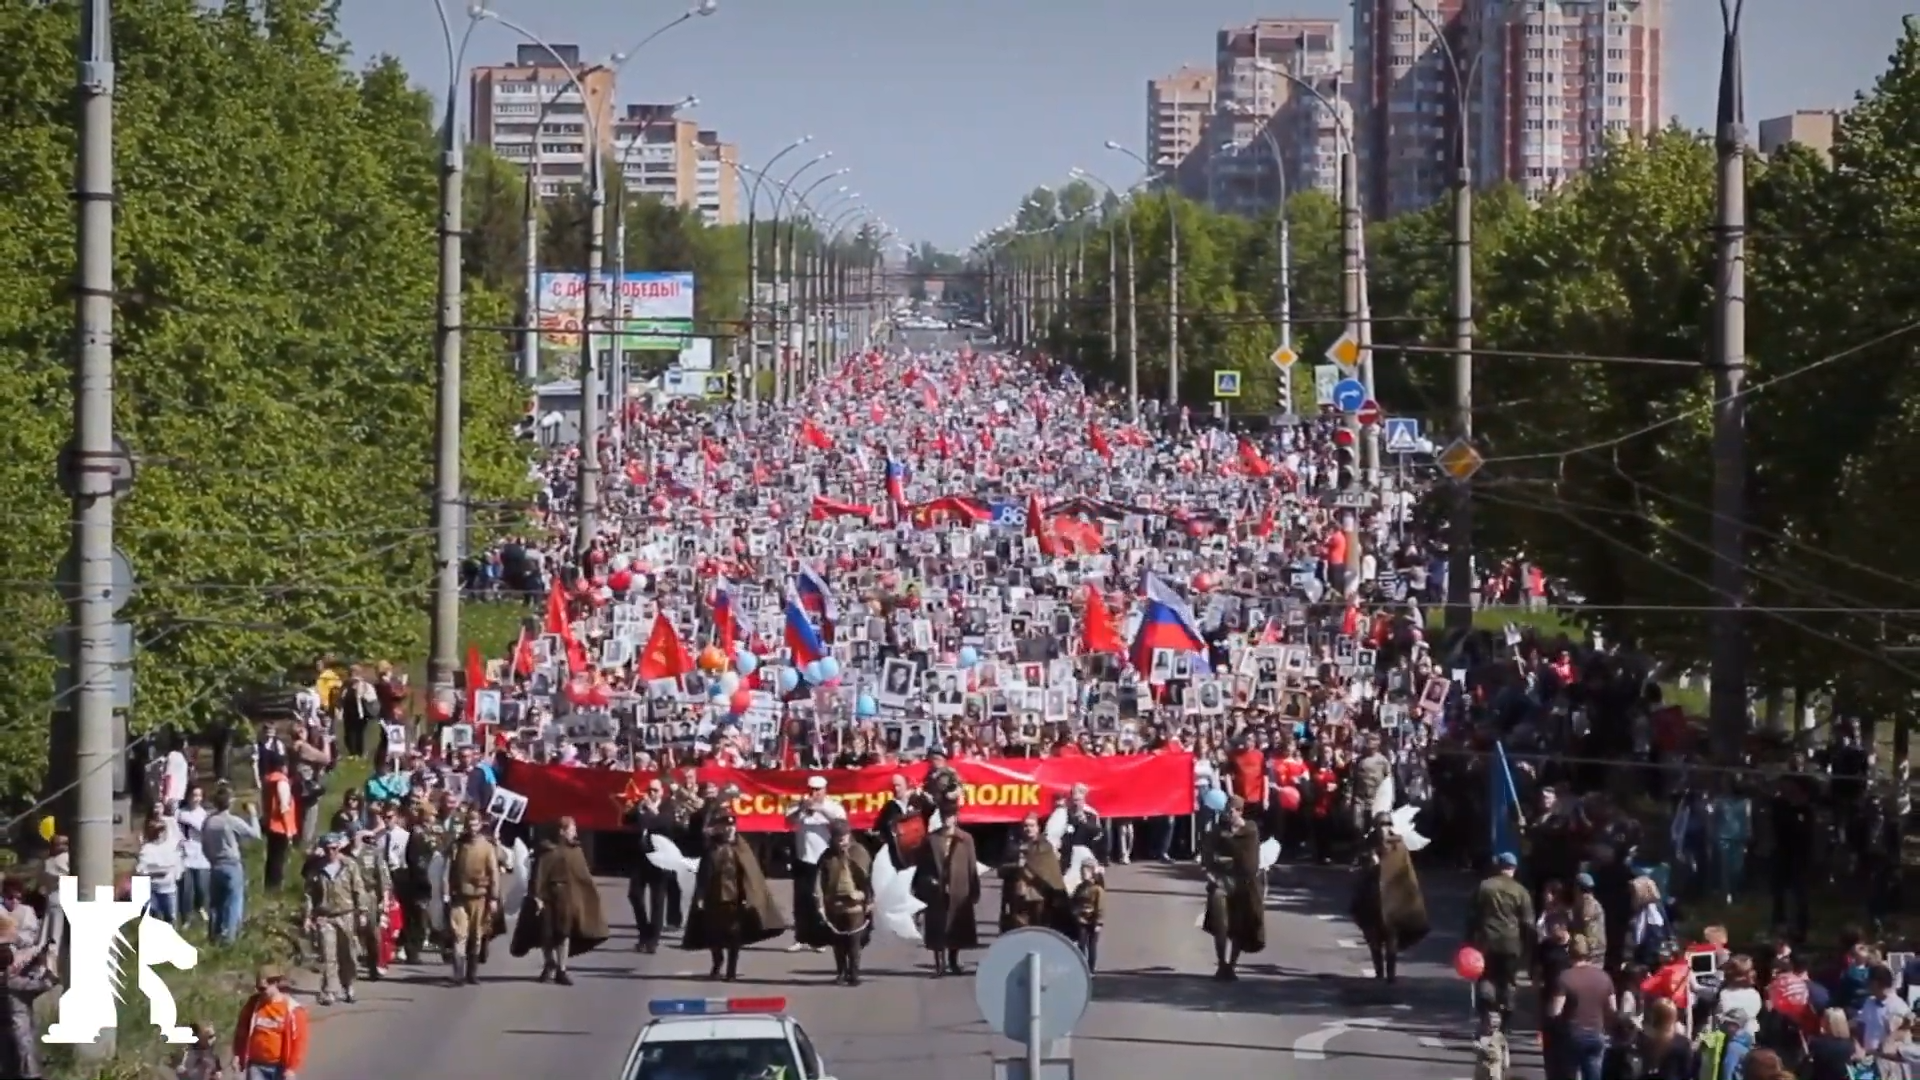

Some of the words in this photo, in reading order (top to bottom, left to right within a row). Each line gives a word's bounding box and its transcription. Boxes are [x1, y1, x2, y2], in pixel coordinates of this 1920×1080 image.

[552, 281, 562, 297] С
[614, 281, 680, 297] ОБЕДЫ!
[961, 783, 1040, 806] ПОЛК
